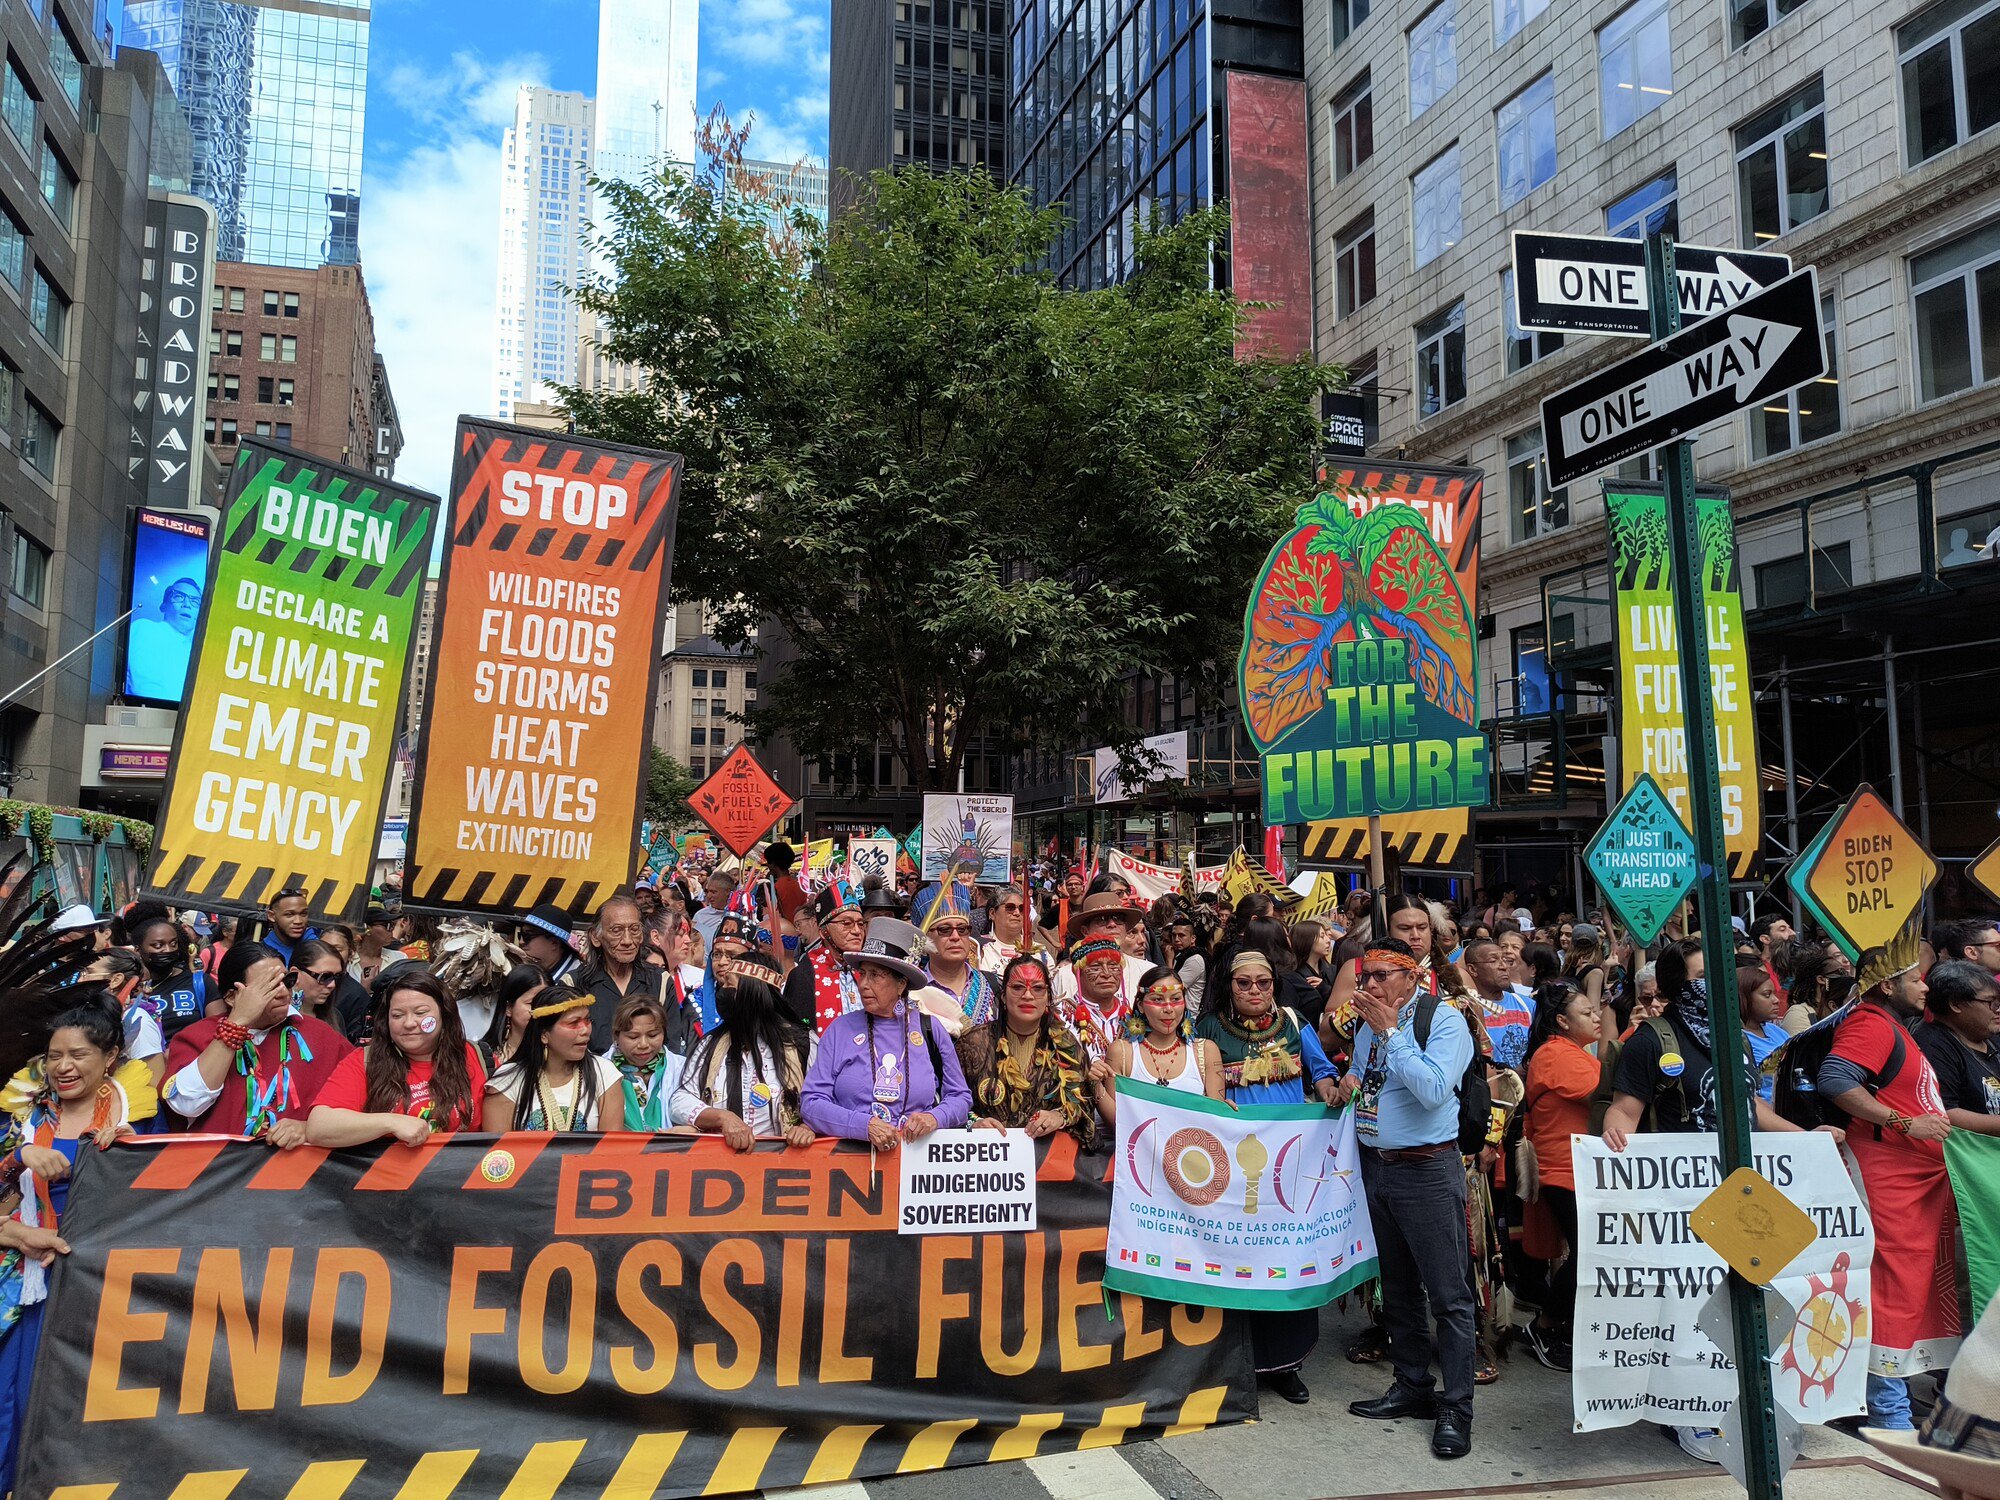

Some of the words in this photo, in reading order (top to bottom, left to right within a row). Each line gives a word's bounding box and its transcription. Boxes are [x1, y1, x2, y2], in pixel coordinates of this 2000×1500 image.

[1559, 266, 1639, 305] ONE
[1676, 276, 1752, 312] WAY
[1575, 321, 1639, 330] TRANSPORTATION
[156, 230, 199, 483] BROADWAY
[1580, 383, 1652, 444] ONE
[1685, 325, 1769, 398] WAY
[1329, 421, 1364, 437] SPACE
[1560, 471, 1576, 481] DEPT
[1596, 438, 1653, 466] TRANSPORTATION
[500, 470, 627, 530] STOP
[143, 513, 165, 528] HERE
[165, 518, 183, 531] LIES
[184, 522, 204, 536] LOVE
[262, 485, 393, 565] BIDEN
[236, 579, 365, 637] DECLARE
[369, 614, 389, 644] A
[488, 571, 620, 618] WILDFIRES
[479, 608, 616, 667] FLOODS
[1631, 605, 1732, 651] LIVLE
[225, 626, 385, 708] CLIMATE
[1337, 639, 1407, 686] FOR
[473, 661, 610, 717] STORMS
[1634, 664, 1738, 714] FUTRE
[1327, 683, 1419, 743] THE
[210, 692, 371, 783] EMER
[490, 713, 589, 767] HEAT
[1641, 727, 1688, 774] FOR
[114, 755, 142, 766] HERE
[144, 755, 167, 766] LIES
[465, 765, 598, 823] WAVES
[722, 783, 761, 793] FOSSIL
[1265, 735, 1487, 825] FUTURE
[193, 771, 362, 857] GENCY
[722, 797, 761, 807] FUELS
[729, 811, 754, 821] KILL
[456, 820, 593, 861] EXTINCTION
[870, 846, 889, 866] NO
[1626, 831, 1661, 847] JUST
[1844, 834, 1892, 857] BIDEN
[1121, 857, 1158, 876] OUR
[1603, 852, 1687, 868] TRANSITION
[1845, 857, 1893, 887] STOP
[1621, 872, 1671, 888] AHEAD
[1847, 887, 1894, 914] DAPL
[928, 1142, 1011, 1163] RESPECT
[911, 1172, 1026, 1194] INDIGENOUS
[1593, 1154, 1793, 1190] INDIGENUS
[573, 1168, 884, 1218] BIDEN
[903, 1202, 1033, 1226] SOVEREIGNTY
[1129, 1202, 1223, 1231] COORDINADORA
[1228, 1221, 1242, 1231] DE
[1247, 1222, 1268, 1232] LAS
[1137, 1217, 1199, 1238] INDÍGENAS
[1203, 1232, 1220, 1244] DE
[1224, 1235, 1239, 1246] LA
[1244, 1236, 1290, 1246] CUENCA
[1295, 1217, 1353, 1246] AMAZÓNICA
[1594, 1265, 1727, 1299] NETWO
[83, 1247, 391, 1422] END
[442, 1238, 873, 1396] FOSSIL
[1605, 1322, 1675, 1342] Defend
[1613, 1348, 1671, 1368] Resist
[1586, 1392, 1732, 1414] www.ienearth.or
